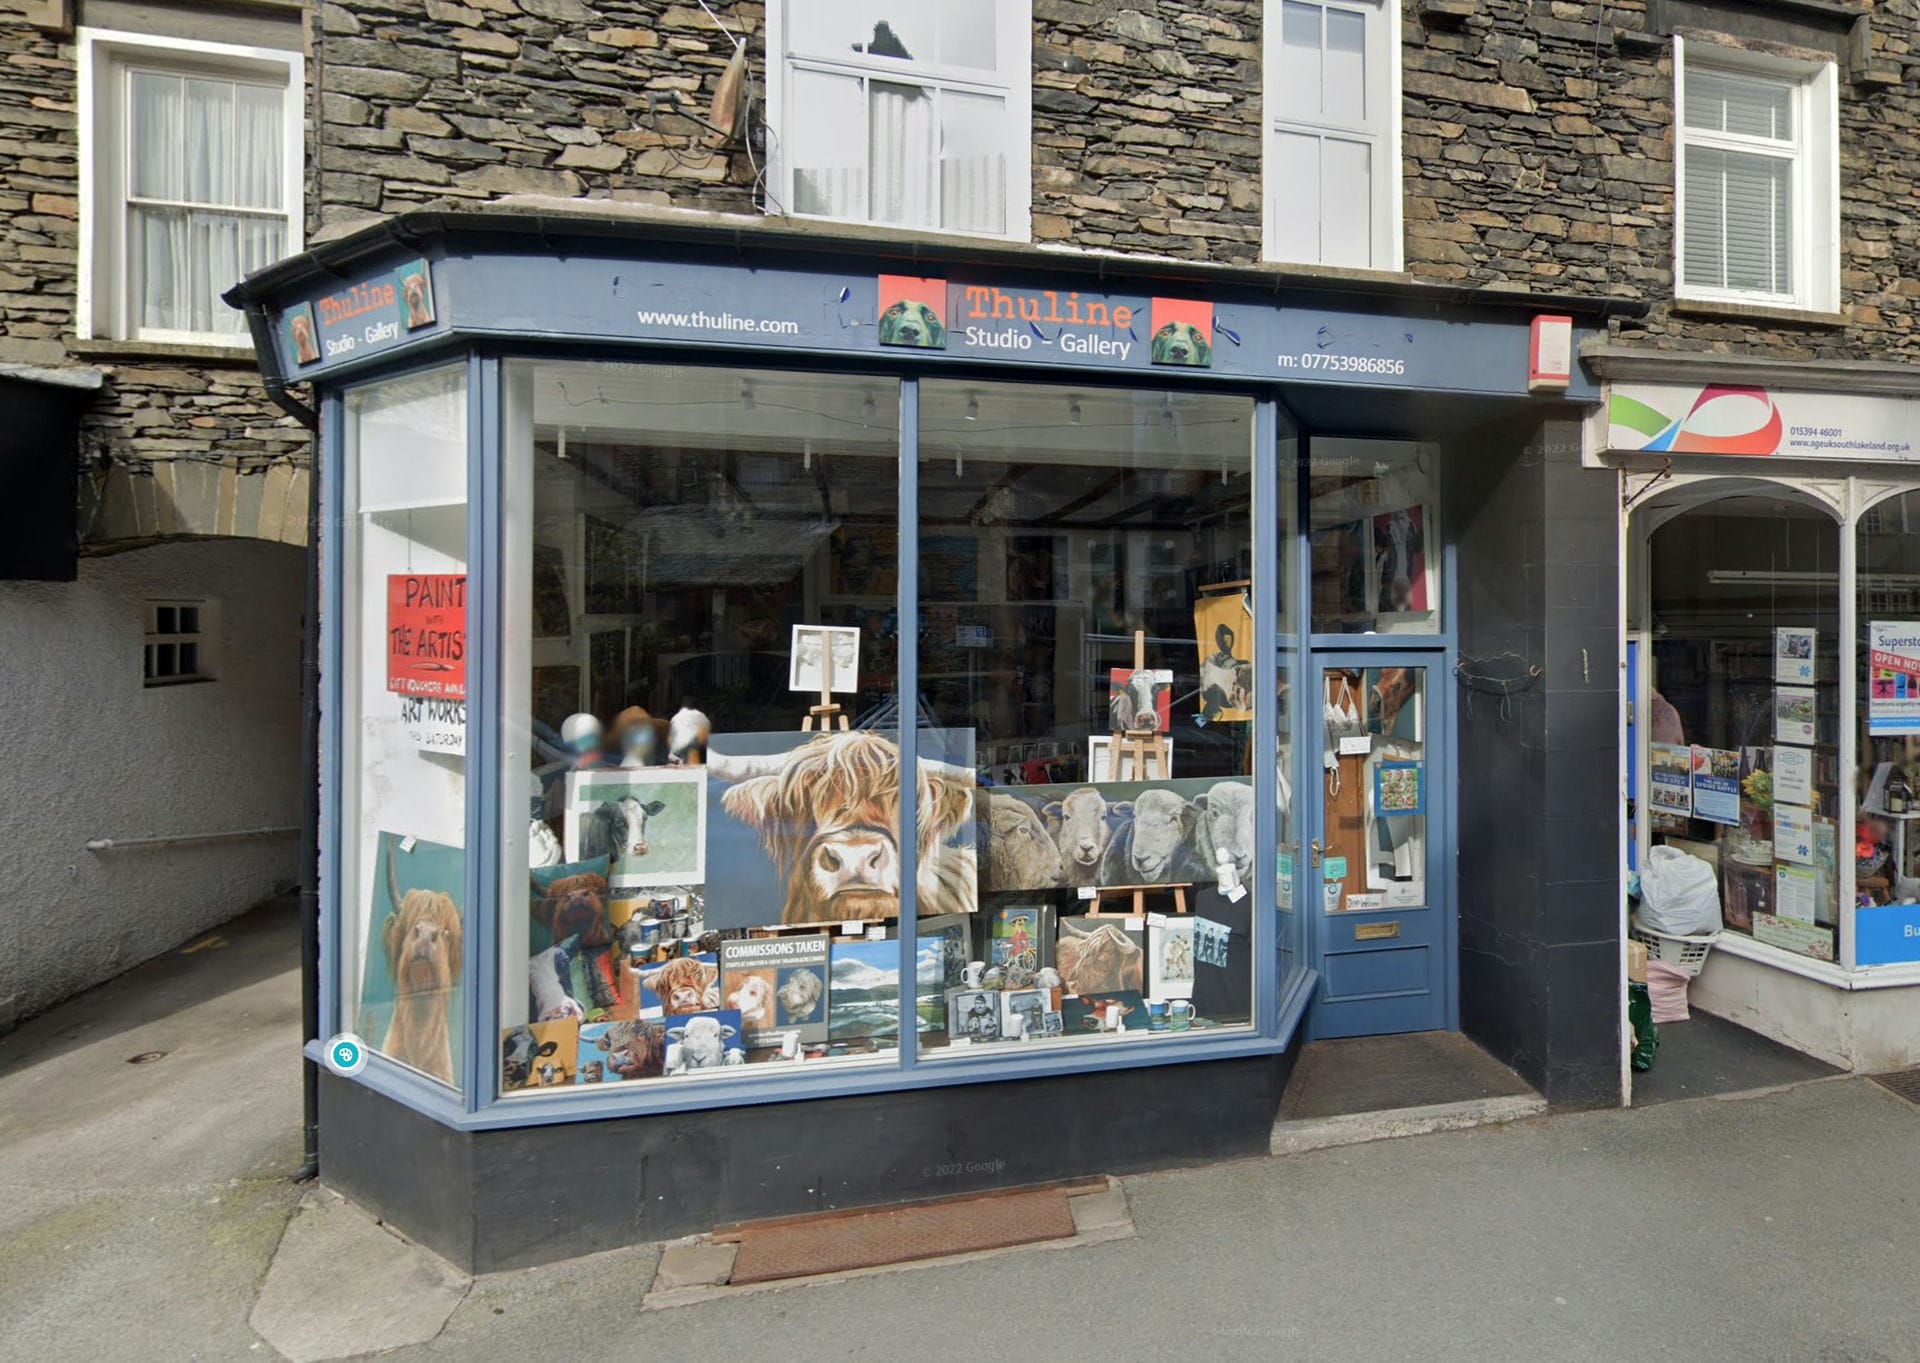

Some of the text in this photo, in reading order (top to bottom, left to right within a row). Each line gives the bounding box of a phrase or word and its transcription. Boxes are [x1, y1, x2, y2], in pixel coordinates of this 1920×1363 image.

[319, 281, 395, 327] Thuline
[965, 285, 1133, 329] Thuline
[637, 311, 799, 334] www.thuline.com
[326, 334, 355, 356] Studio
[365, 322, 398, 344] Gallery
[965, 326, 1032, 350] Studio
[1060, 333, 1131, 361] Gallery
[1277, 353, 1405, 375] m: 07753986856
[1790, 427, 1842, 437] 015394 46001
[1789, 440, 1910, 453] www.ageuksouthlakeland.org.uk
[405, 577, 467, 608] PAINT
[390, 624, 413, 656] THE
[416, 630, 467, 661] ARTIS
[1874, 652, 1901, 667] OPEN
[1903, 659, 1920, 672] NO
[401, 697, 424, 724] ART
[725, 939, 826, 959] COMMISSIONS TAKEN
